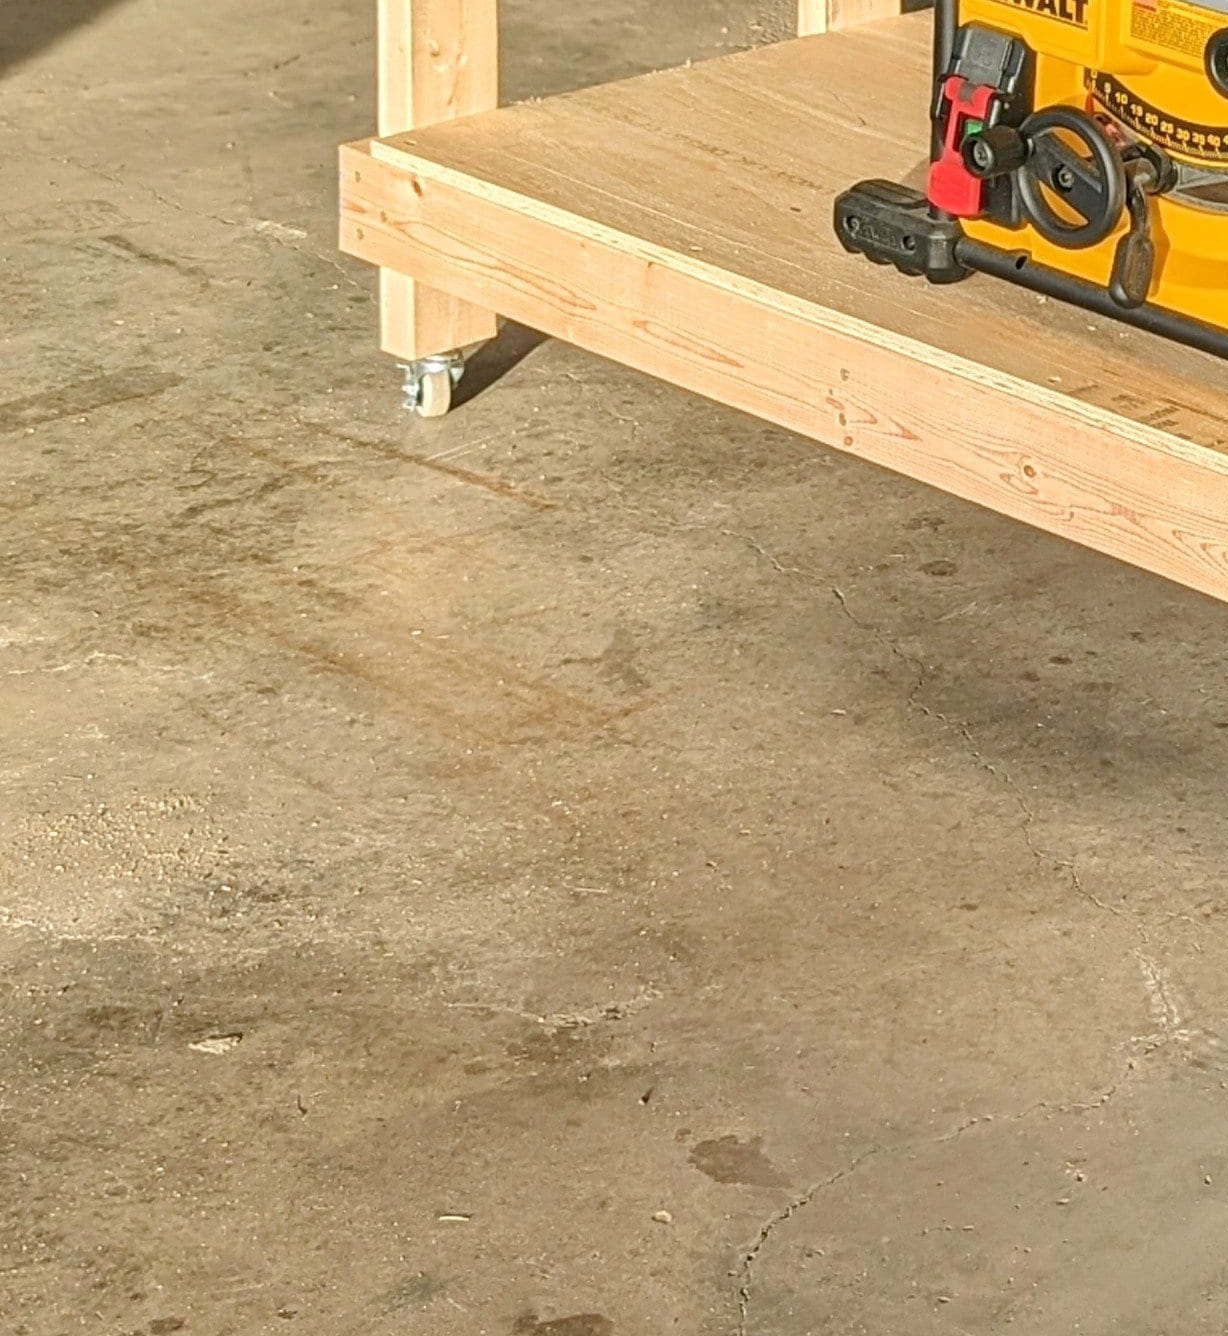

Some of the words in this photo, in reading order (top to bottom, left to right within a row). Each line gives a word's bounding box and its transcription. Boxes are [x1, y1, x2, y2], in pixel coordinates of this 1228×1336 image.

[1115, 91, 1128, 105] 10
[1130, 103, 1143, 117] 15
[1145, 113, 1158, 126] 20
[1160, 121, 1174, 134] 25
[1176, 128, 1190, 141] 30
[1192, 132, 1205, 146] 35
[1207, 133, 1221, 147] 40
